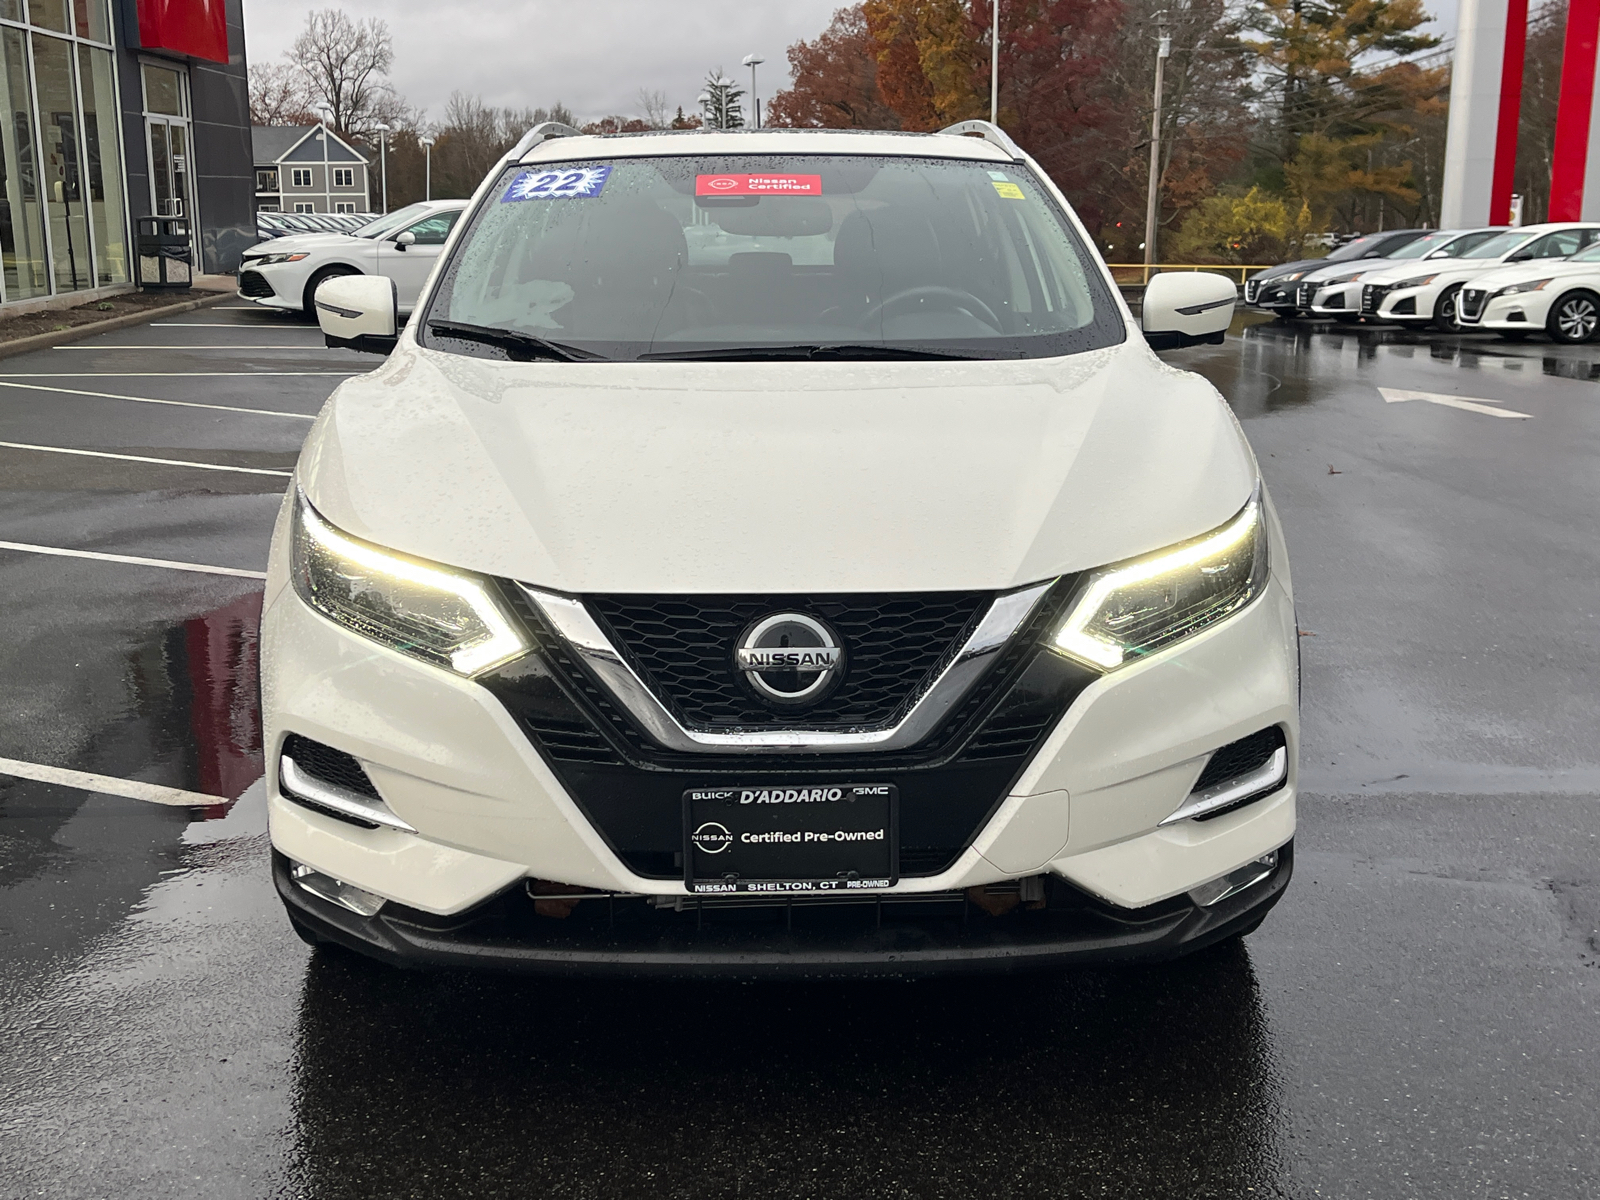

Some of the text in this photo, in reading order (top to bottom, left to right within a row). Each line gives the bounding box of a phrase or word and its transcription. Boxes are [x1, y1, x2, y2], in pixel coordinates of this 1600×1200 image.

[526, 172, 585, 193] 22
[749, 652, 830, 665] NISSAN
[692, 792, 733, 800] BUICK
[739, 788, 842, 805] D'ADDARIO
[852, 787, 889, 795] GMC
[740, 829, 884, 843] Certified Pre-Owned
[694, 884, 737, 893] NISSAN
[747, 881, 838, 892] SHELTON, CT
[847, 880, 889, 889] PRE-OWNED
